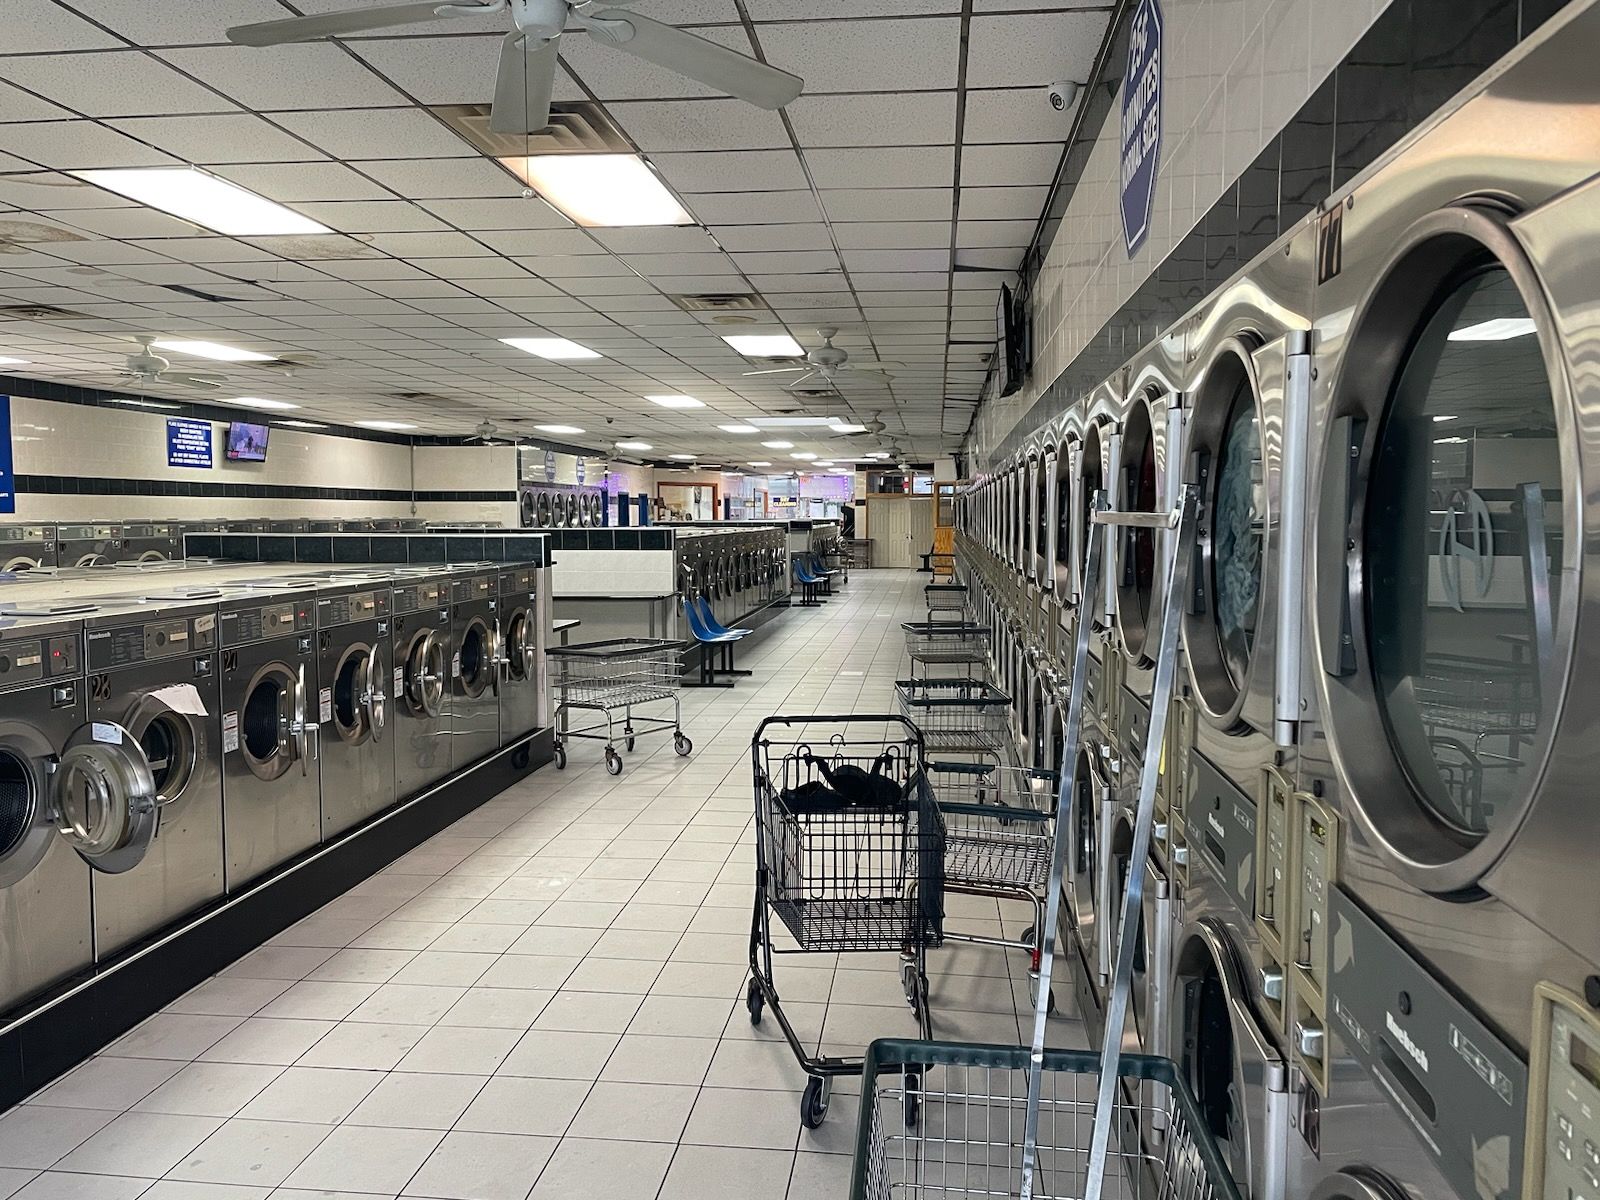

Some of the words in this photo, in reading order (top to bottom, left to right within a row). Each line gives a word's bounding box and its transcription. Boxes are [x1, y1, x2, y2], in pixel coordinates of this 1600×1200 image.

[1126, 48, 1158, 142] MINUTES
[1142, 102, 1158, 158] SIZE
[1320, 205, 1342, 281] 77
[92, 675, 111, 701] 28
[224, 651, 238, 672] 27
